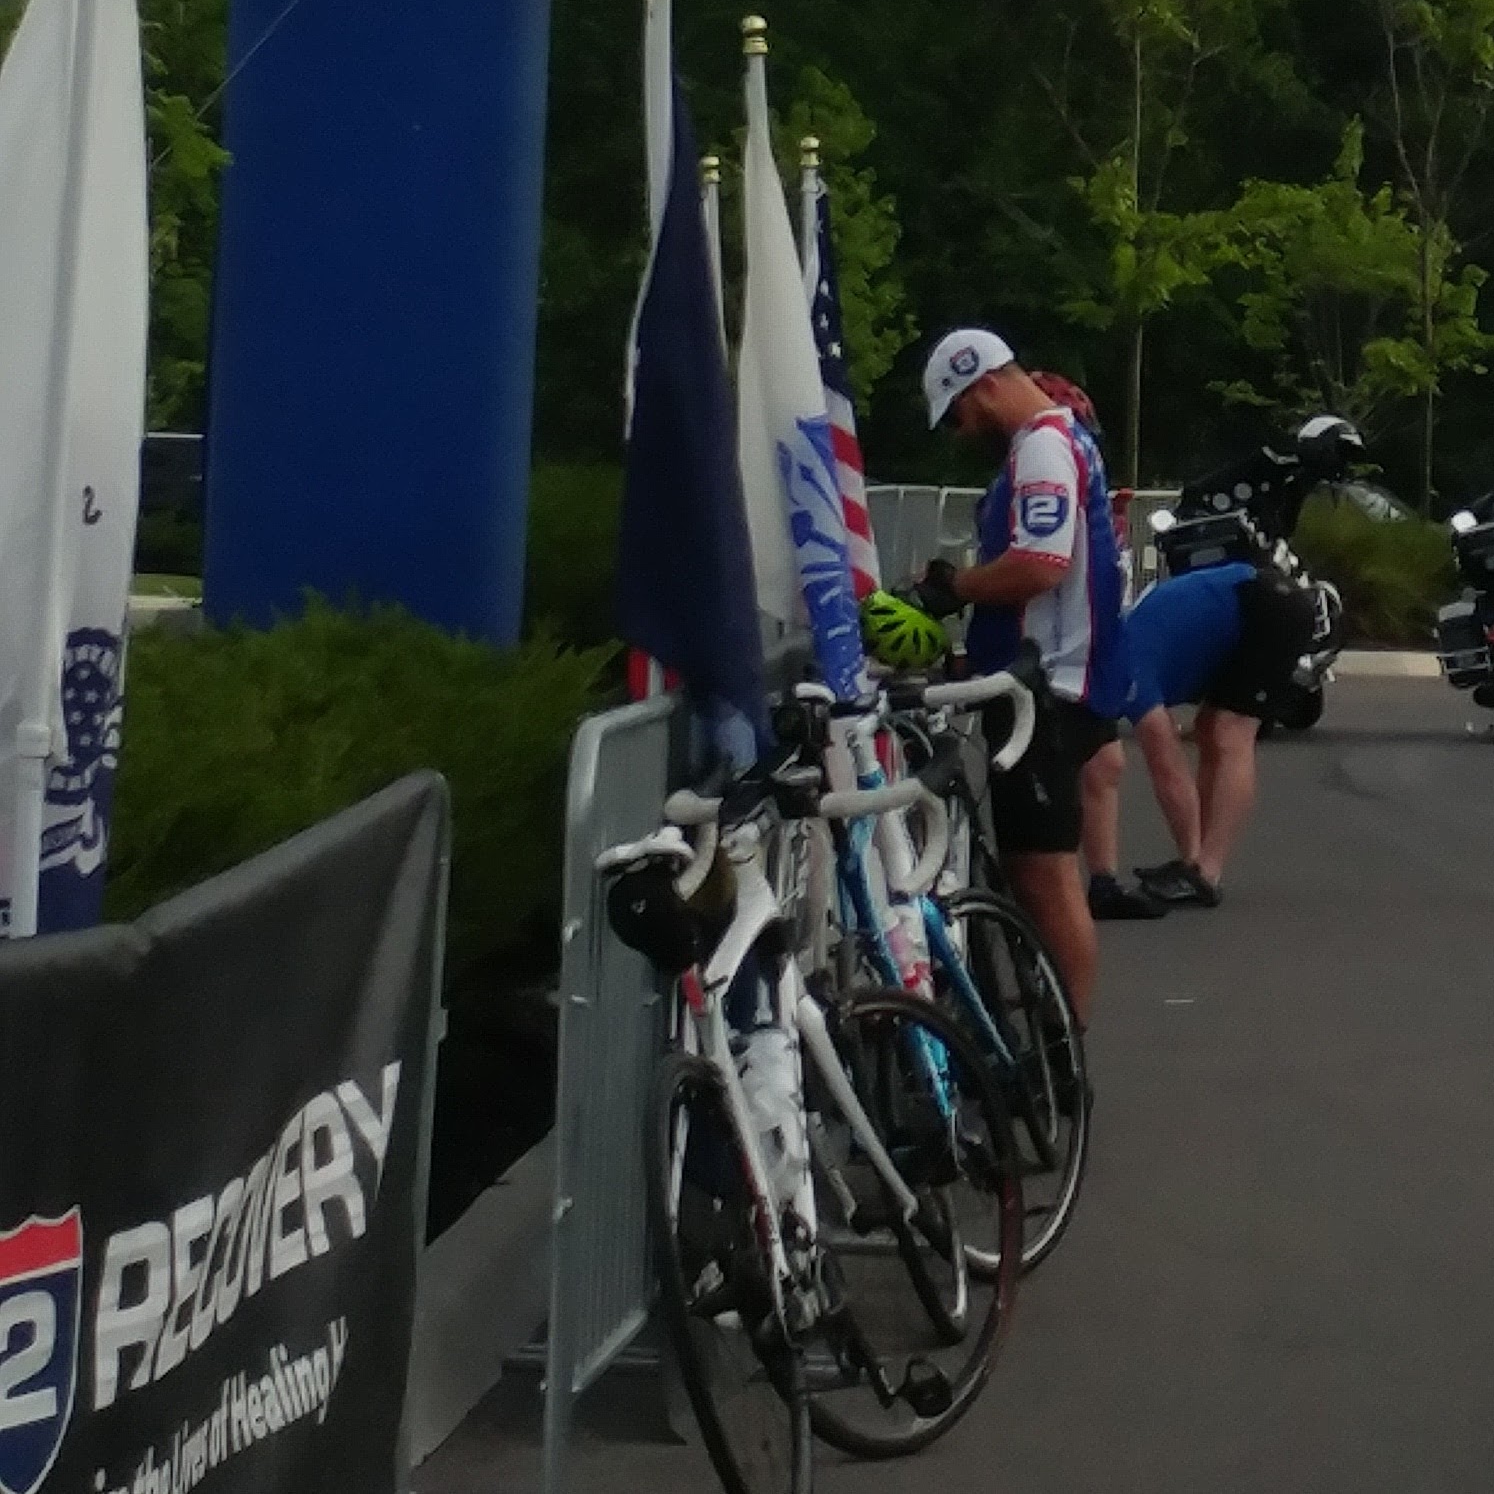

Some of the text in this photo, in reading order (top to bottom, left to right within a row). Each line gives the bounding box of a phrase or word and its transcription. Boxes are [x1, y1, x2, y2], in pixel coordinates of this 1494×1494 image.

[1027, 495, 1059, 526] 2
[0, 1291, 57, 1430] 2
[230, 1343, 330, 1453] Healing
